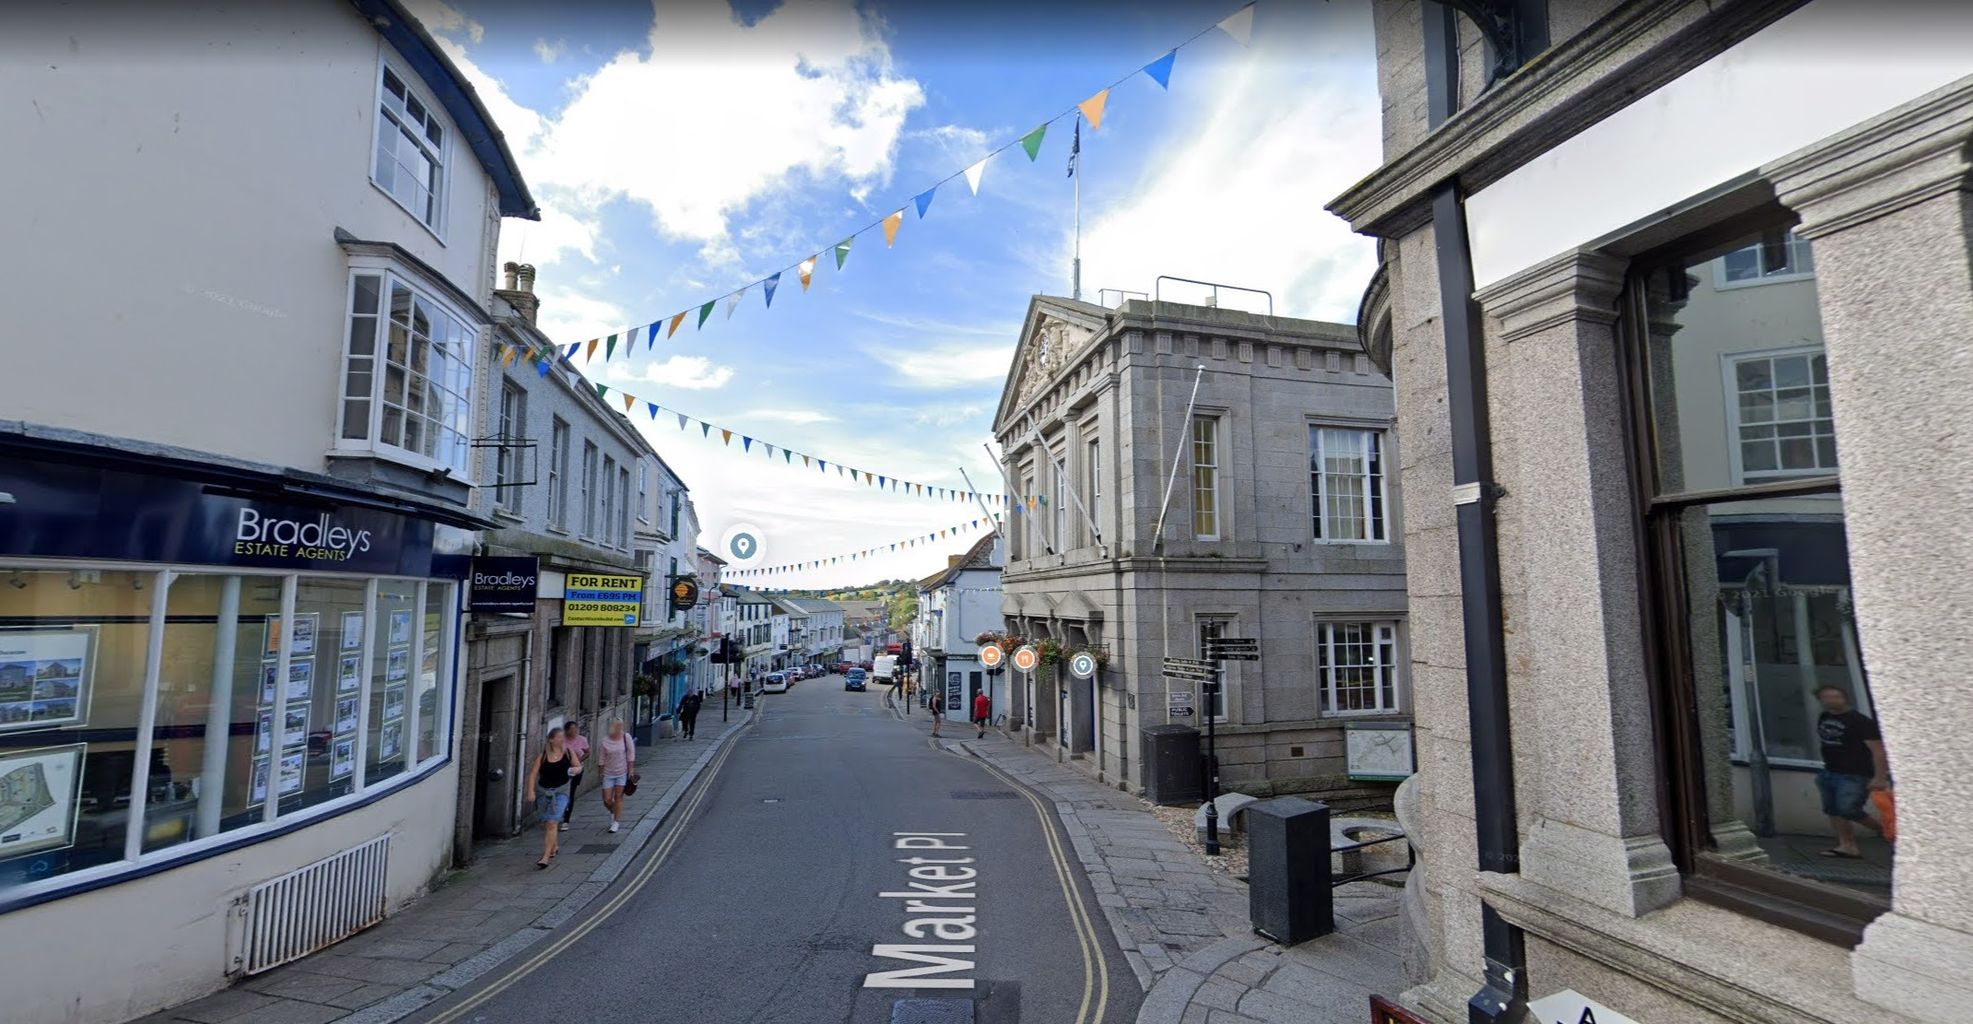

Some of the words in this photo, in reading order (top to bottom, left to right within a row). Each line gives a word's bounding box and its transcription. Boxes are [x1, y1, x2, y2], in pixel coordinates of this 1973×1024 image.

[236, 507, 372, 560] Bradleys
[234, 541, 289, 557] ESTATE
[295, 546, 346, 561] AGENTS
[474, 571, 535, 589] Bradleys
[571, 576, 599, 587] FOR
[600, 577, 638, 589] RENT
[570, 591, 596, 600] From
[622, 593, 637, 601] PM
[568, 603, 599, 611] 01209
[600, 604, 636, 612] 808234
